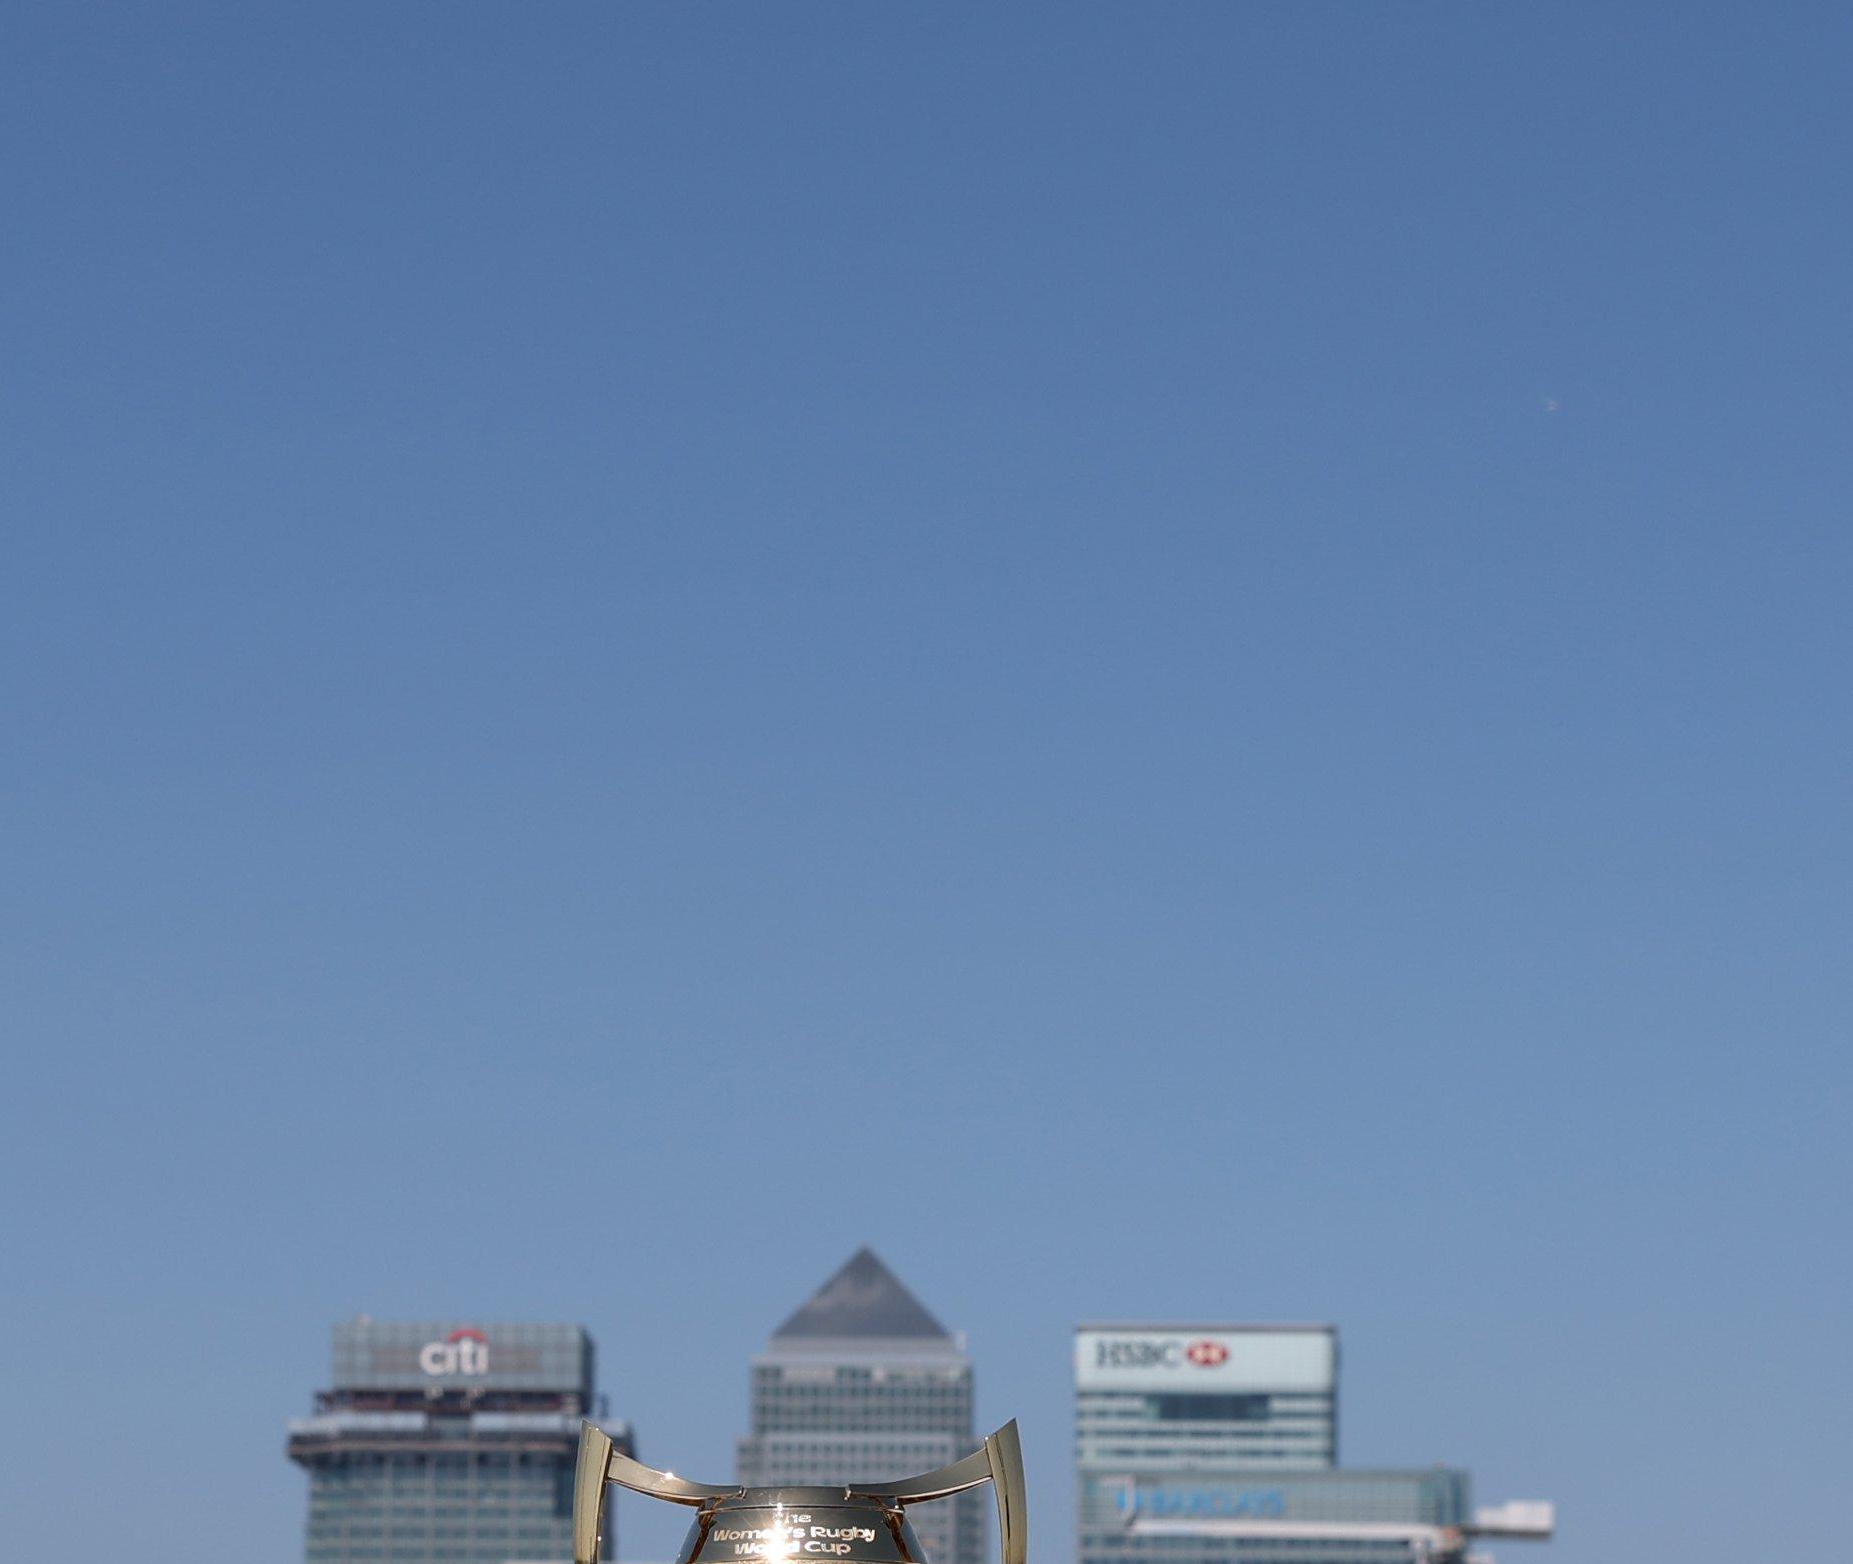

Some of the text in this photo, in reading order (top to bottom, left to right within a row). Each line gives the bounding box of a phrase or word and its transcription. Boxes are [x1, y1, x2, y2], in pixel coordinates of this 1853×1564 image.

[419, 1331, 489, 1376] citi
[1096, 1340, 1182, 1368] HSBC
[1150, 1489, 1285, 1517] BARCLAYS
[804, 1540, 852, 1556] Cup
[810, 1525, 876, 1543] Rugby
